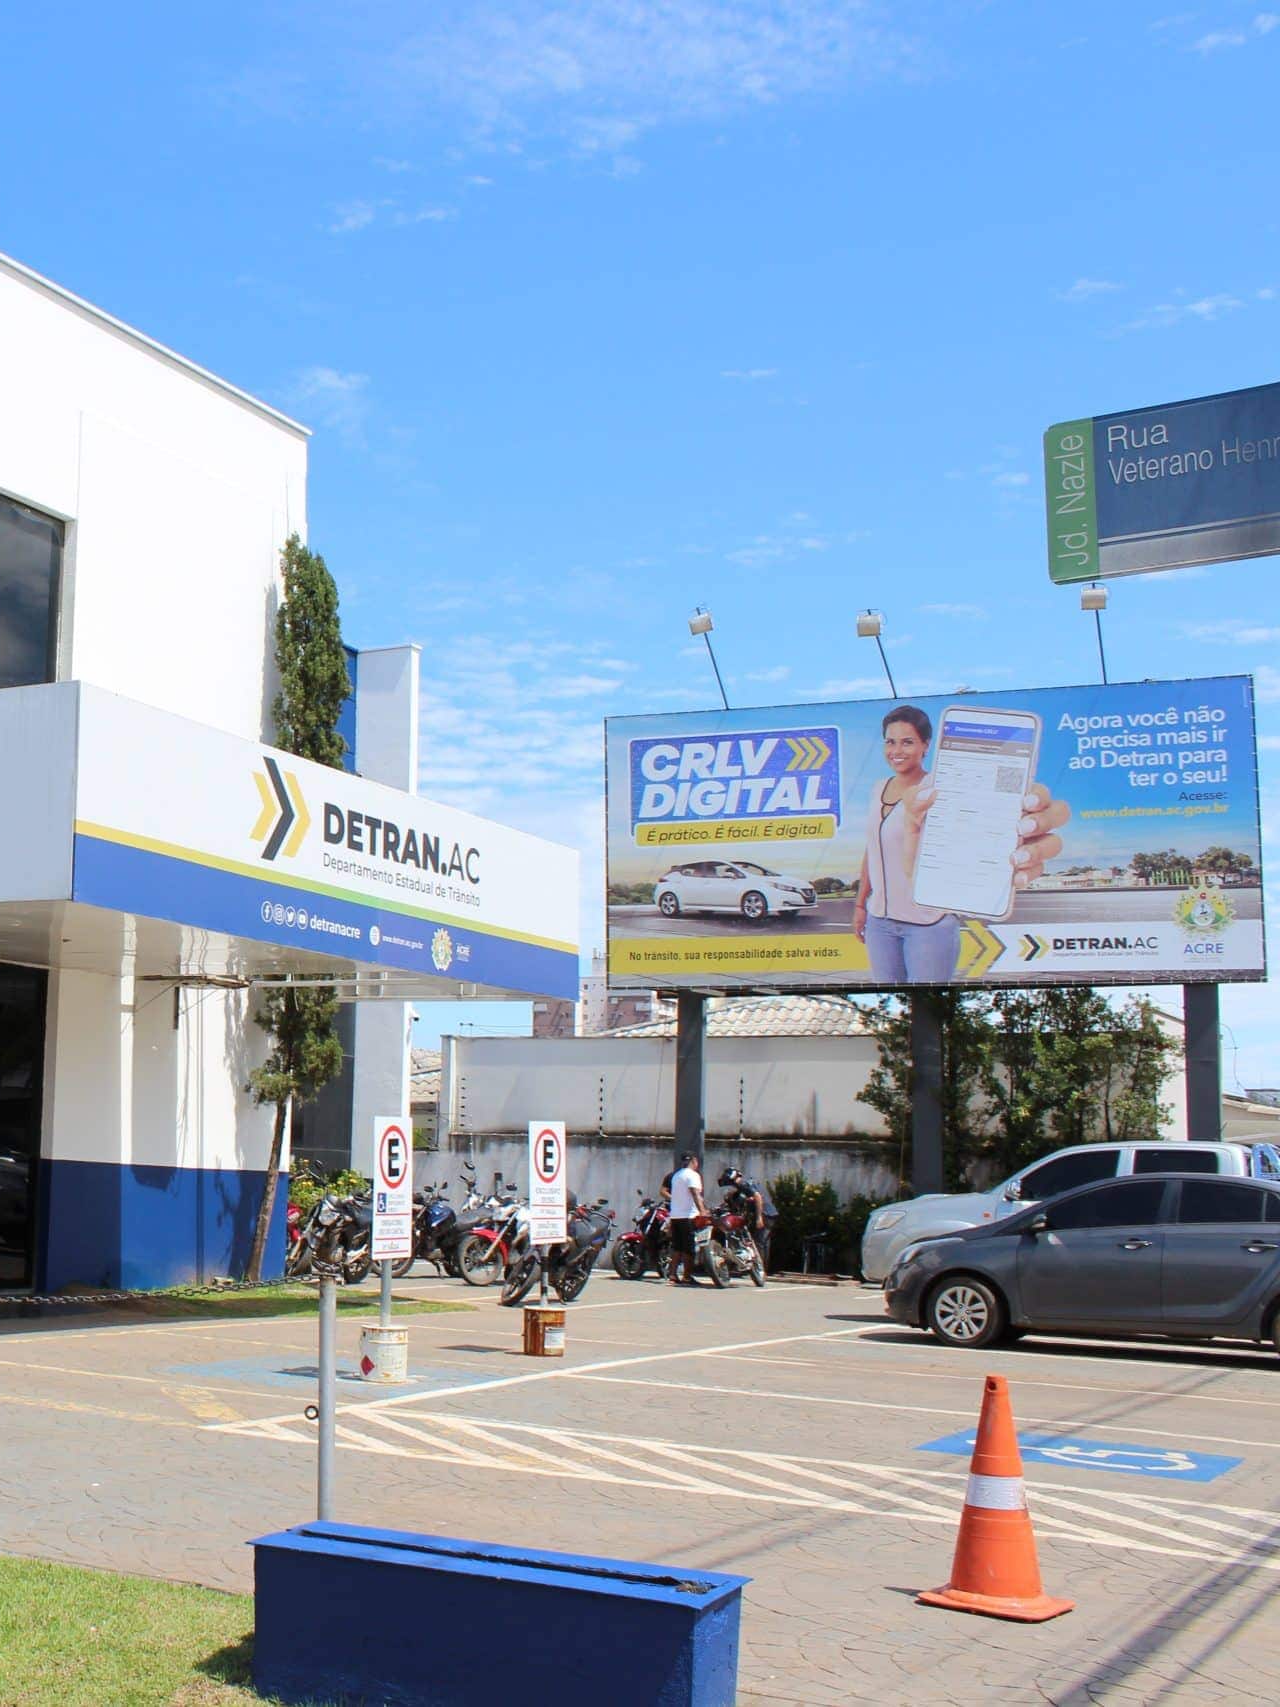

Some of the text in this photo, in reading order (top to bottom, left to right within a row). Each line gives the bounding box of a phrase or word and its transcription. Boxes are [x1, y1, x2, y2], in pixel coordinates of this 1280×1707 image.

[1107, 424, 1168, 452] Rua
[1108, 449, 1213, 484] Veterano
[1057, 523, 1089, 566] Jd.
[1057, 705, 1226, 735] Agora você não
[1077, 725, 1228, 754] precisa mais ir
[641, 738, 780, 782] CRLV
[1069, 749, 1228, 770] ao Detran para
[1128, 764, 1228, 787] ter o seu!
[639, 775, 831, 818] DIGITAL
[1178, 791, 1228, 802] Acesse:
[324, 802, 480, 885] DETRAN.AC
[647, 828, 657, 842] É
[714, 824, 725, 839] É
[727, 823, 760, 838] fácil.
[763, 823, 773, 837] É
[776, 822, 824, 837] digital.
[323, 853, 393, 885] Departamento
[396, 873, 434, 895] Estadual
[435, 883, 446, 898] de
[310, 915, 360, 939] detranacre
[629, 951, 642, 961] No
[684, 951, 701, 961] sua
[703, 948, 782, 961] responsabilidade
[786, 947, 810, 959] salva
[814, 946, 842, 958] vidas.
[1052, 936, 1159, 951] DETRAN.AC
[1183, 943, 1225, 955] ACRE
[388, 1138, 400, 1178] E
[543, 1139, 554, 1173] E
